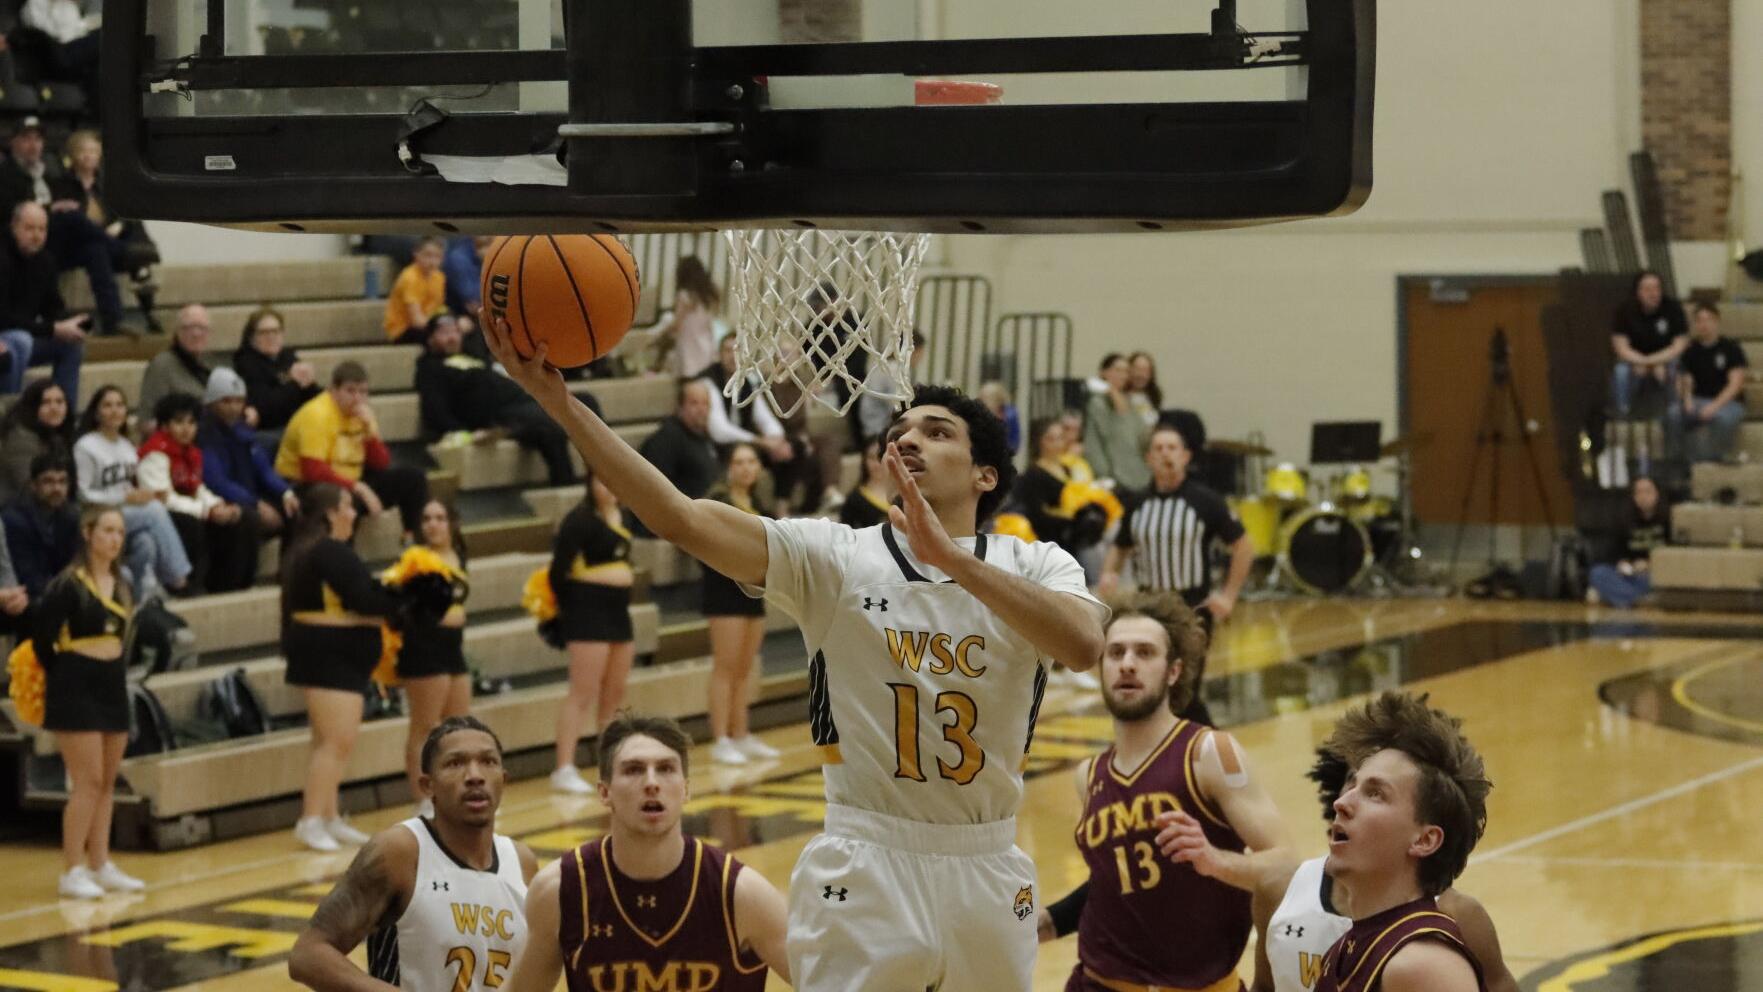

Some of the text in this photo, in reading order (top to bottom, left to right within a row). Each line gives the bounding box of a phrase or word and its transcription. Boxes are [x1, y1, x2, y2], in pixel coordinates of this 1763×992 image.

[884, 627, 988, 679] WSC
[885, 682, 986, 786] 13
[1113, 840, 1161, 895] 13
[449, 902, 515, 942] WSC
[443, 945, 512, 992] 25
[588, 959, 721, 992] UMD
